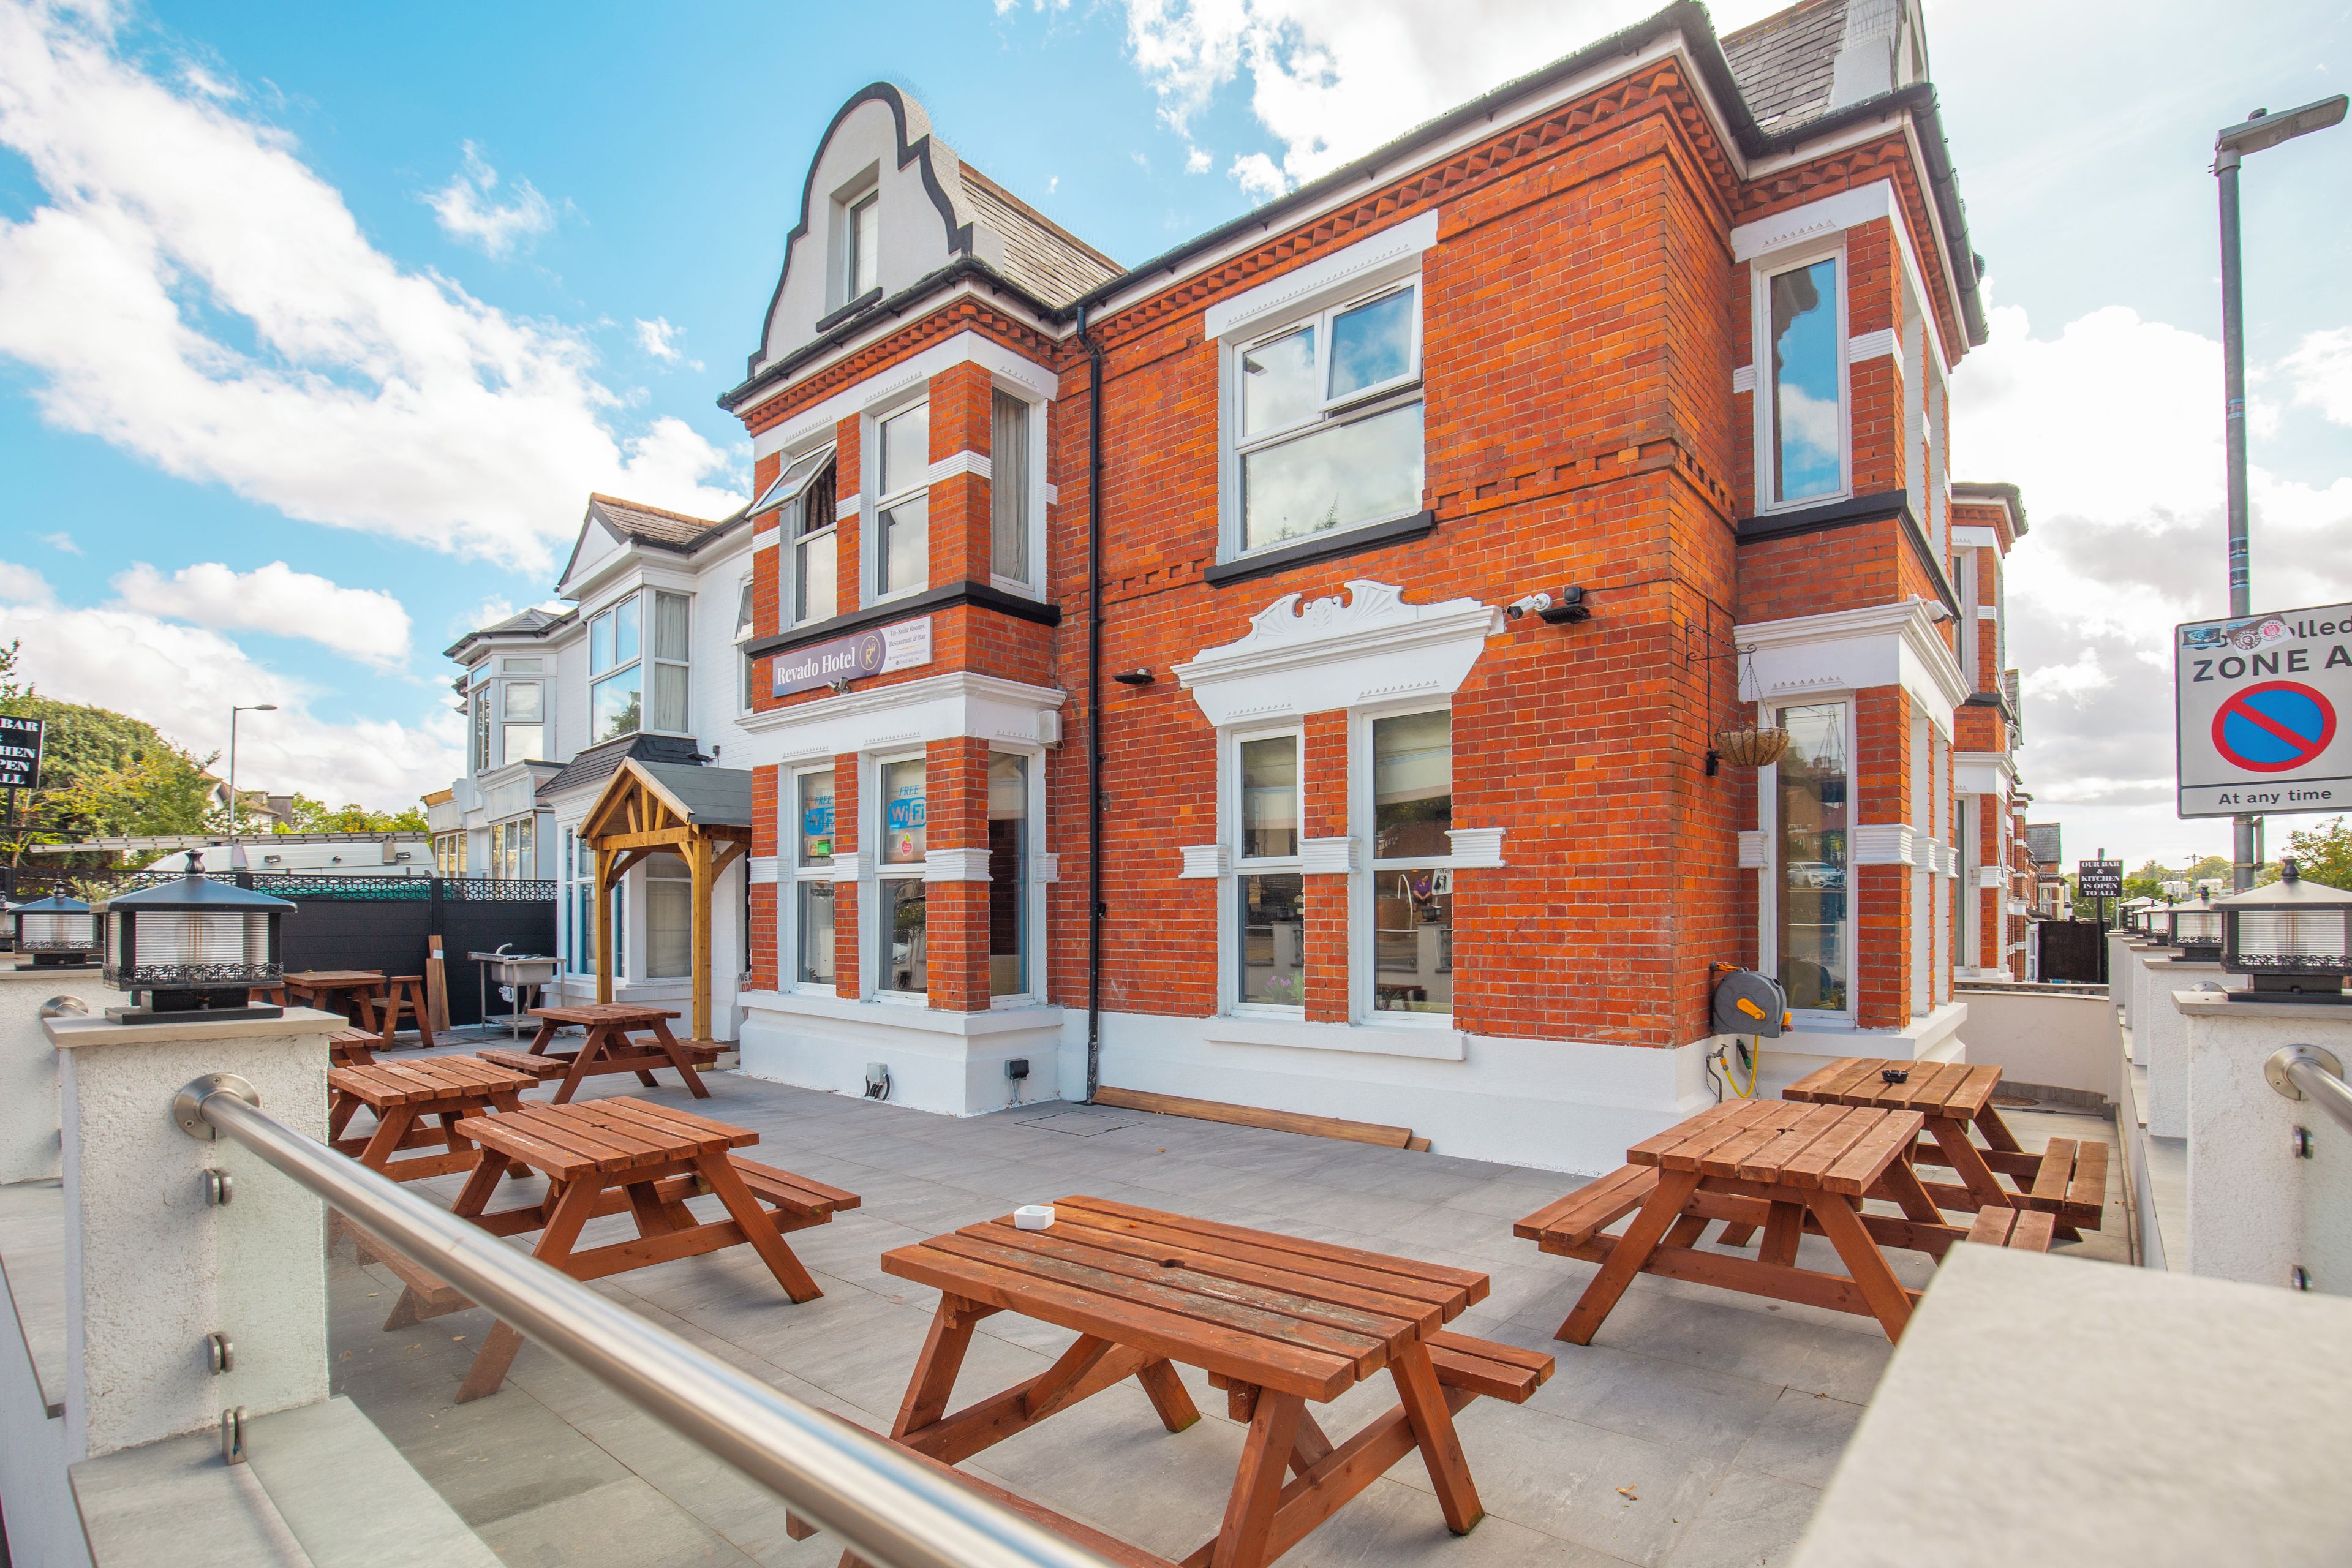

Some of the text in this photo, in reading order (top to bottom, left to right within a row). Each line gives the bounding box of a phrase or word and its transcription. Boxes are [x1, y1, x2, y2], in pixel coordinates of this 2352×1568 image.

[889, 636, 912, 647] Restaurant
[777, 647, 856, 685] Revado Hotel
[2193, 645, 2352, 682] ZONE A
[0, 718, 39, 731] BAR
[0, 773, 26, 785] LL
[899, 785, 919, 796] FREE
[2218, 790, 2331, 804] At any time
[815, 796, 832, 805] FREE
[892, 803, 924, 821] WiFi
[809, 813, 834, 829] WiF
